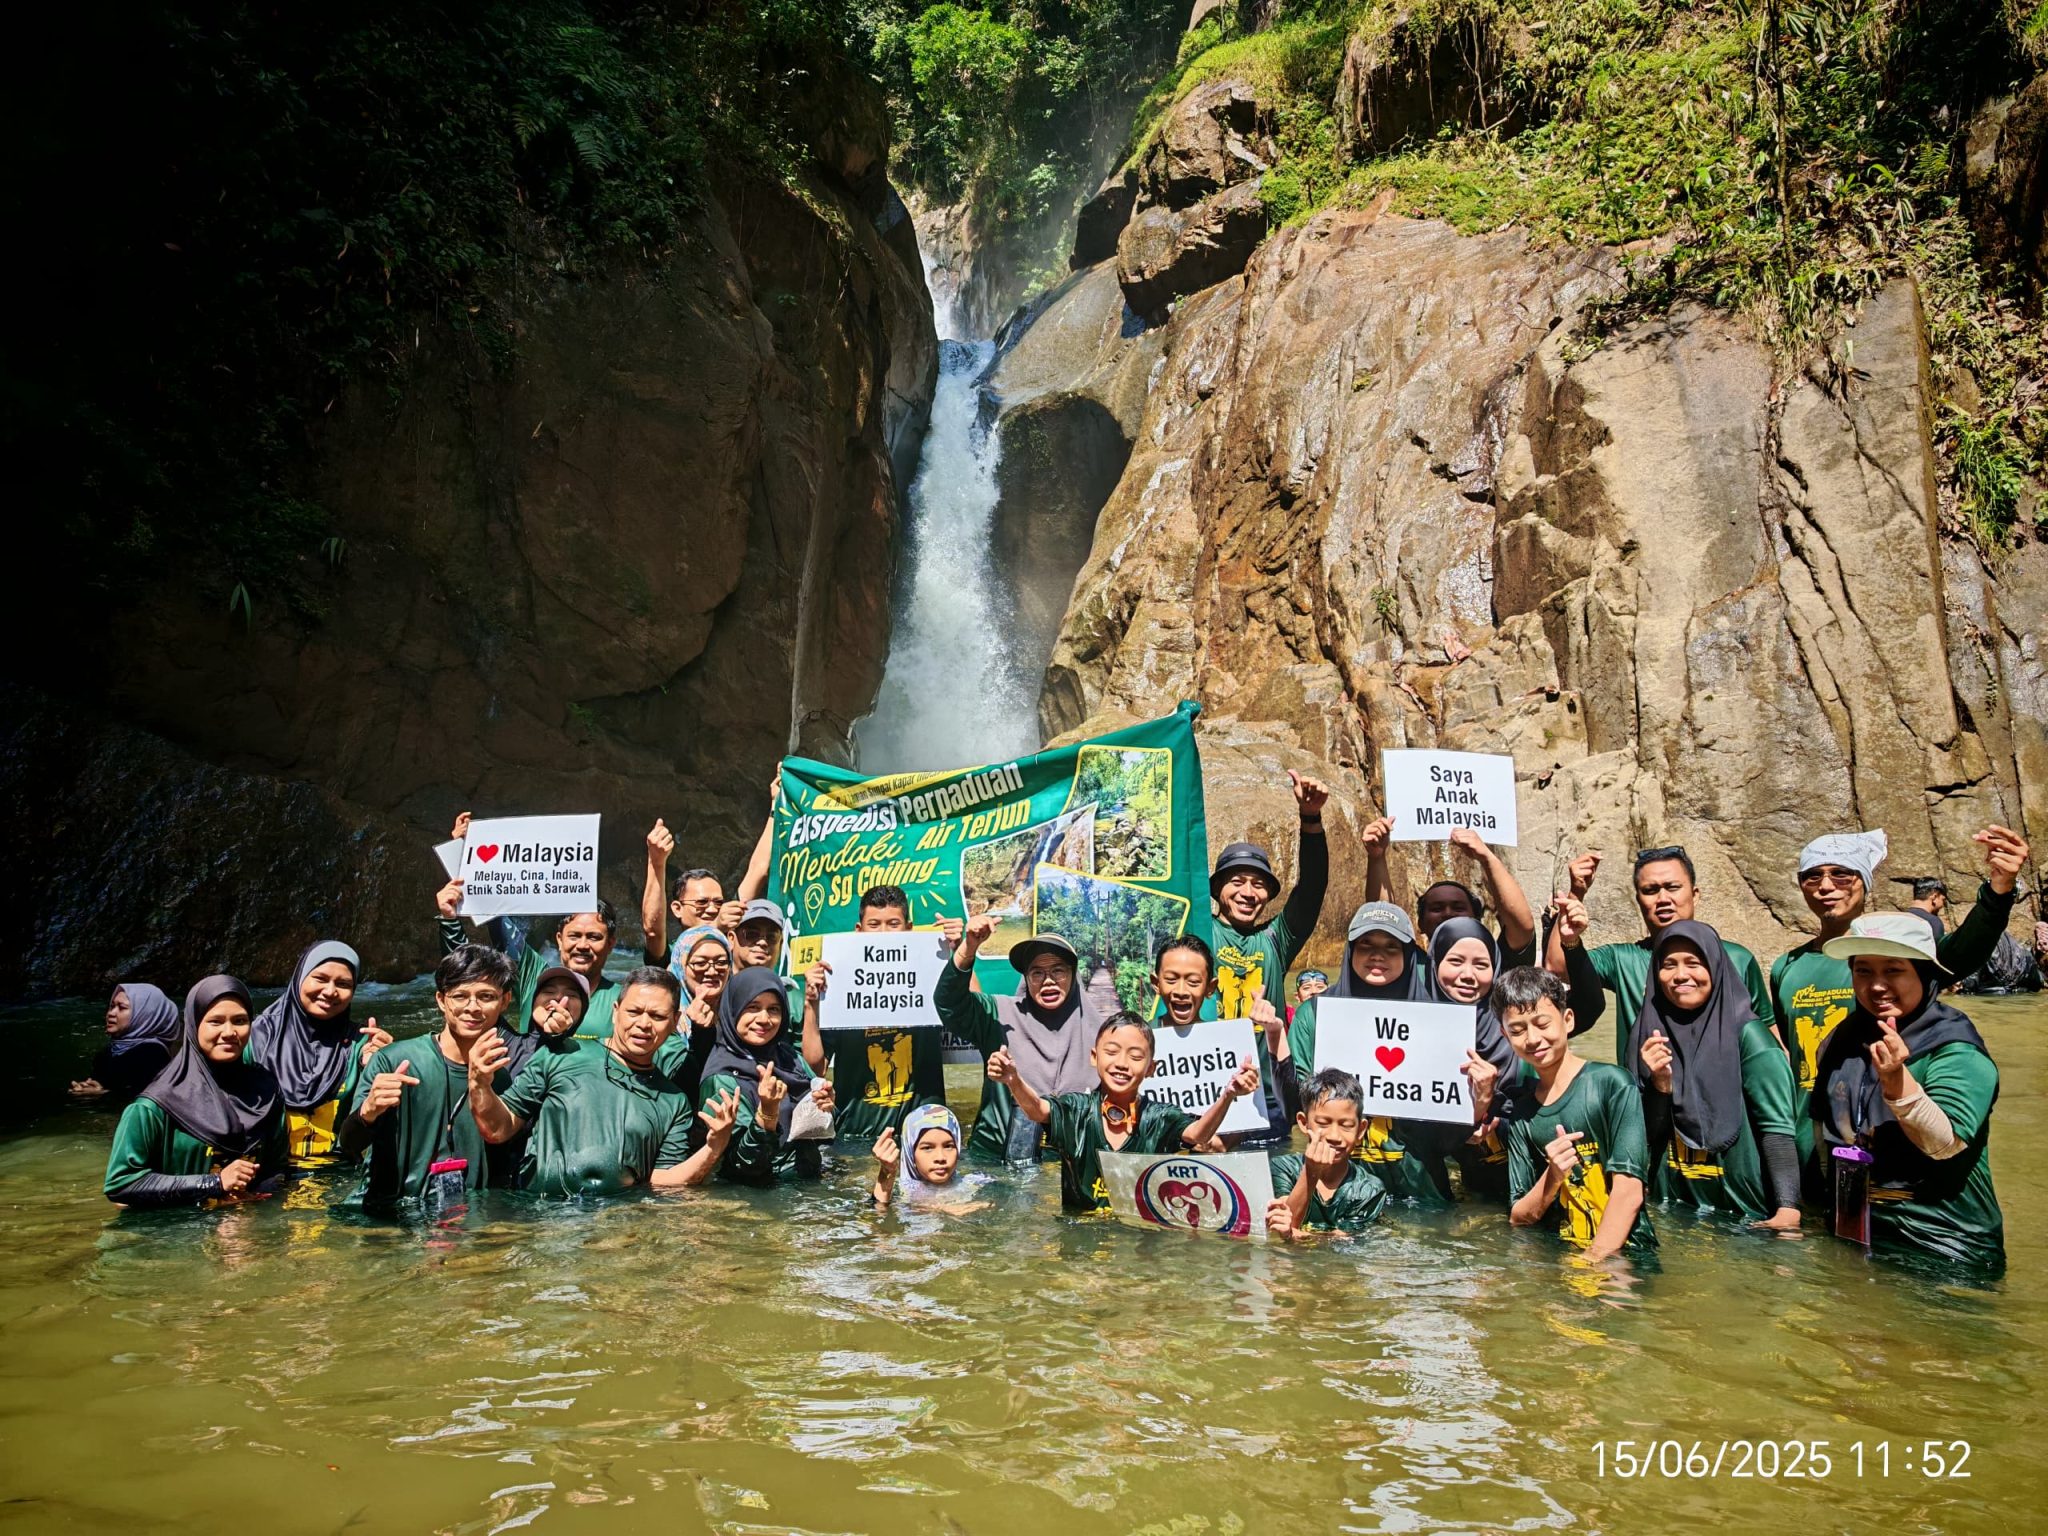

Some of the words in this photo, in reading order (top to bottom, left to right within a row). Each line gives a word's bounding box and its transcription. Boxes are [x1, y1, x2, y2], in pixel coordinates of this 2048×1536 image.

[892, 774, 916, 791] Kapar
[1430, 765, 1473, 787] Saya
[788, 801, 898, 849] Ekspedisi
[898, 762, 1024, 828] Perpaduan
[1435, 786, 1479, 806] Anak
[1416, 807, 1496, 829] Malaysia
[467, 846, 474, 865] I
[502, 842, 594, 867] Malaysia
[779, 831, 905, 894] Mendaki
[915, 818, 957, 852] Air
[956, 798, 1032, 844] Terjun
[474, 870, 517, 884] Melayu,
[520, 869, 549, 881] Cina,
[552, 869, 583, 881] India,
[828, 875, 854, 907] Sg
[857, 857, 940, 898] Chiling
[466, 884, 493, 896] Etnik
[495, 883, 529, 895] Sabah
[532, 883, 541, 895] &
[544, 882, 591, 895] Sarawak
[798, 946, 814, 964] 15
[864, 945, 908, 963] Kami
[854, 968, 917, 990] Sayang
[846, 990, 924, 1013] Malaysia
[1374, 1016, 1410, 1042] We
[1145, 1047, 1238, 1079] alaysia
[1144, 1081, 1238, 1109] Dihatik
[1369, 1075, 1422, 1102] Fasa
[1431, 1080, 1462, 1106] 5A
[1167, 1165, 1199, 1179] KRT
